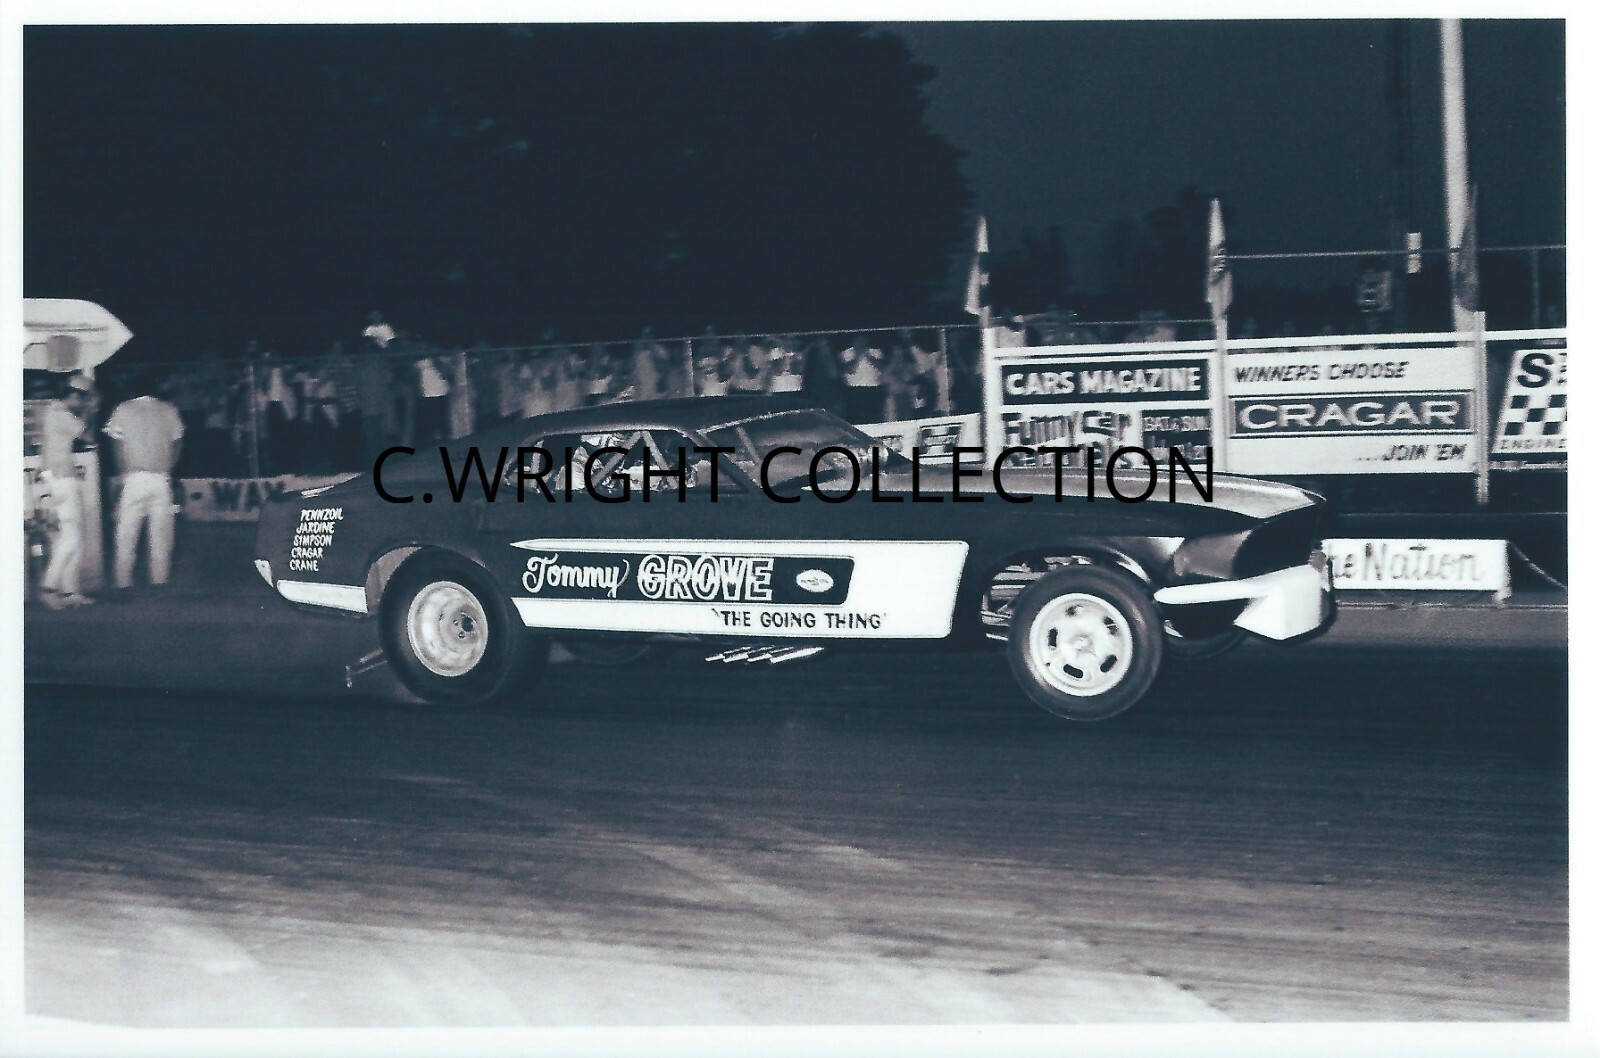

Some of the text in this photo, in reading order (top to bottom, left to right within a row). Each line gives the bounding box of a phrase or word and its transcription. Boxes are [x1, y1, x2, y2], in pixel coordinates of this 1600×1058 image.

[1234, 360, 1410, 383] WINNERS CHOOSE
[1005, 366, 1202, 396] CARS MAGAZINE
[1239, 400, 1462, 430] CRAGAR
[300, 508, 344, 521] PENNZOIL
[296, 521, 336, 534] JARDINE
[293, 534, 333, 547] SIMPSON
[291, 547, 324, 559] CRAGAR
[290, 559, 319, 572] CRANE
[1363, 542, 1486, 582] Nation
[522, 553, 774, 601] Tommy GROVE
[760, 612, 817, 629] GOING
